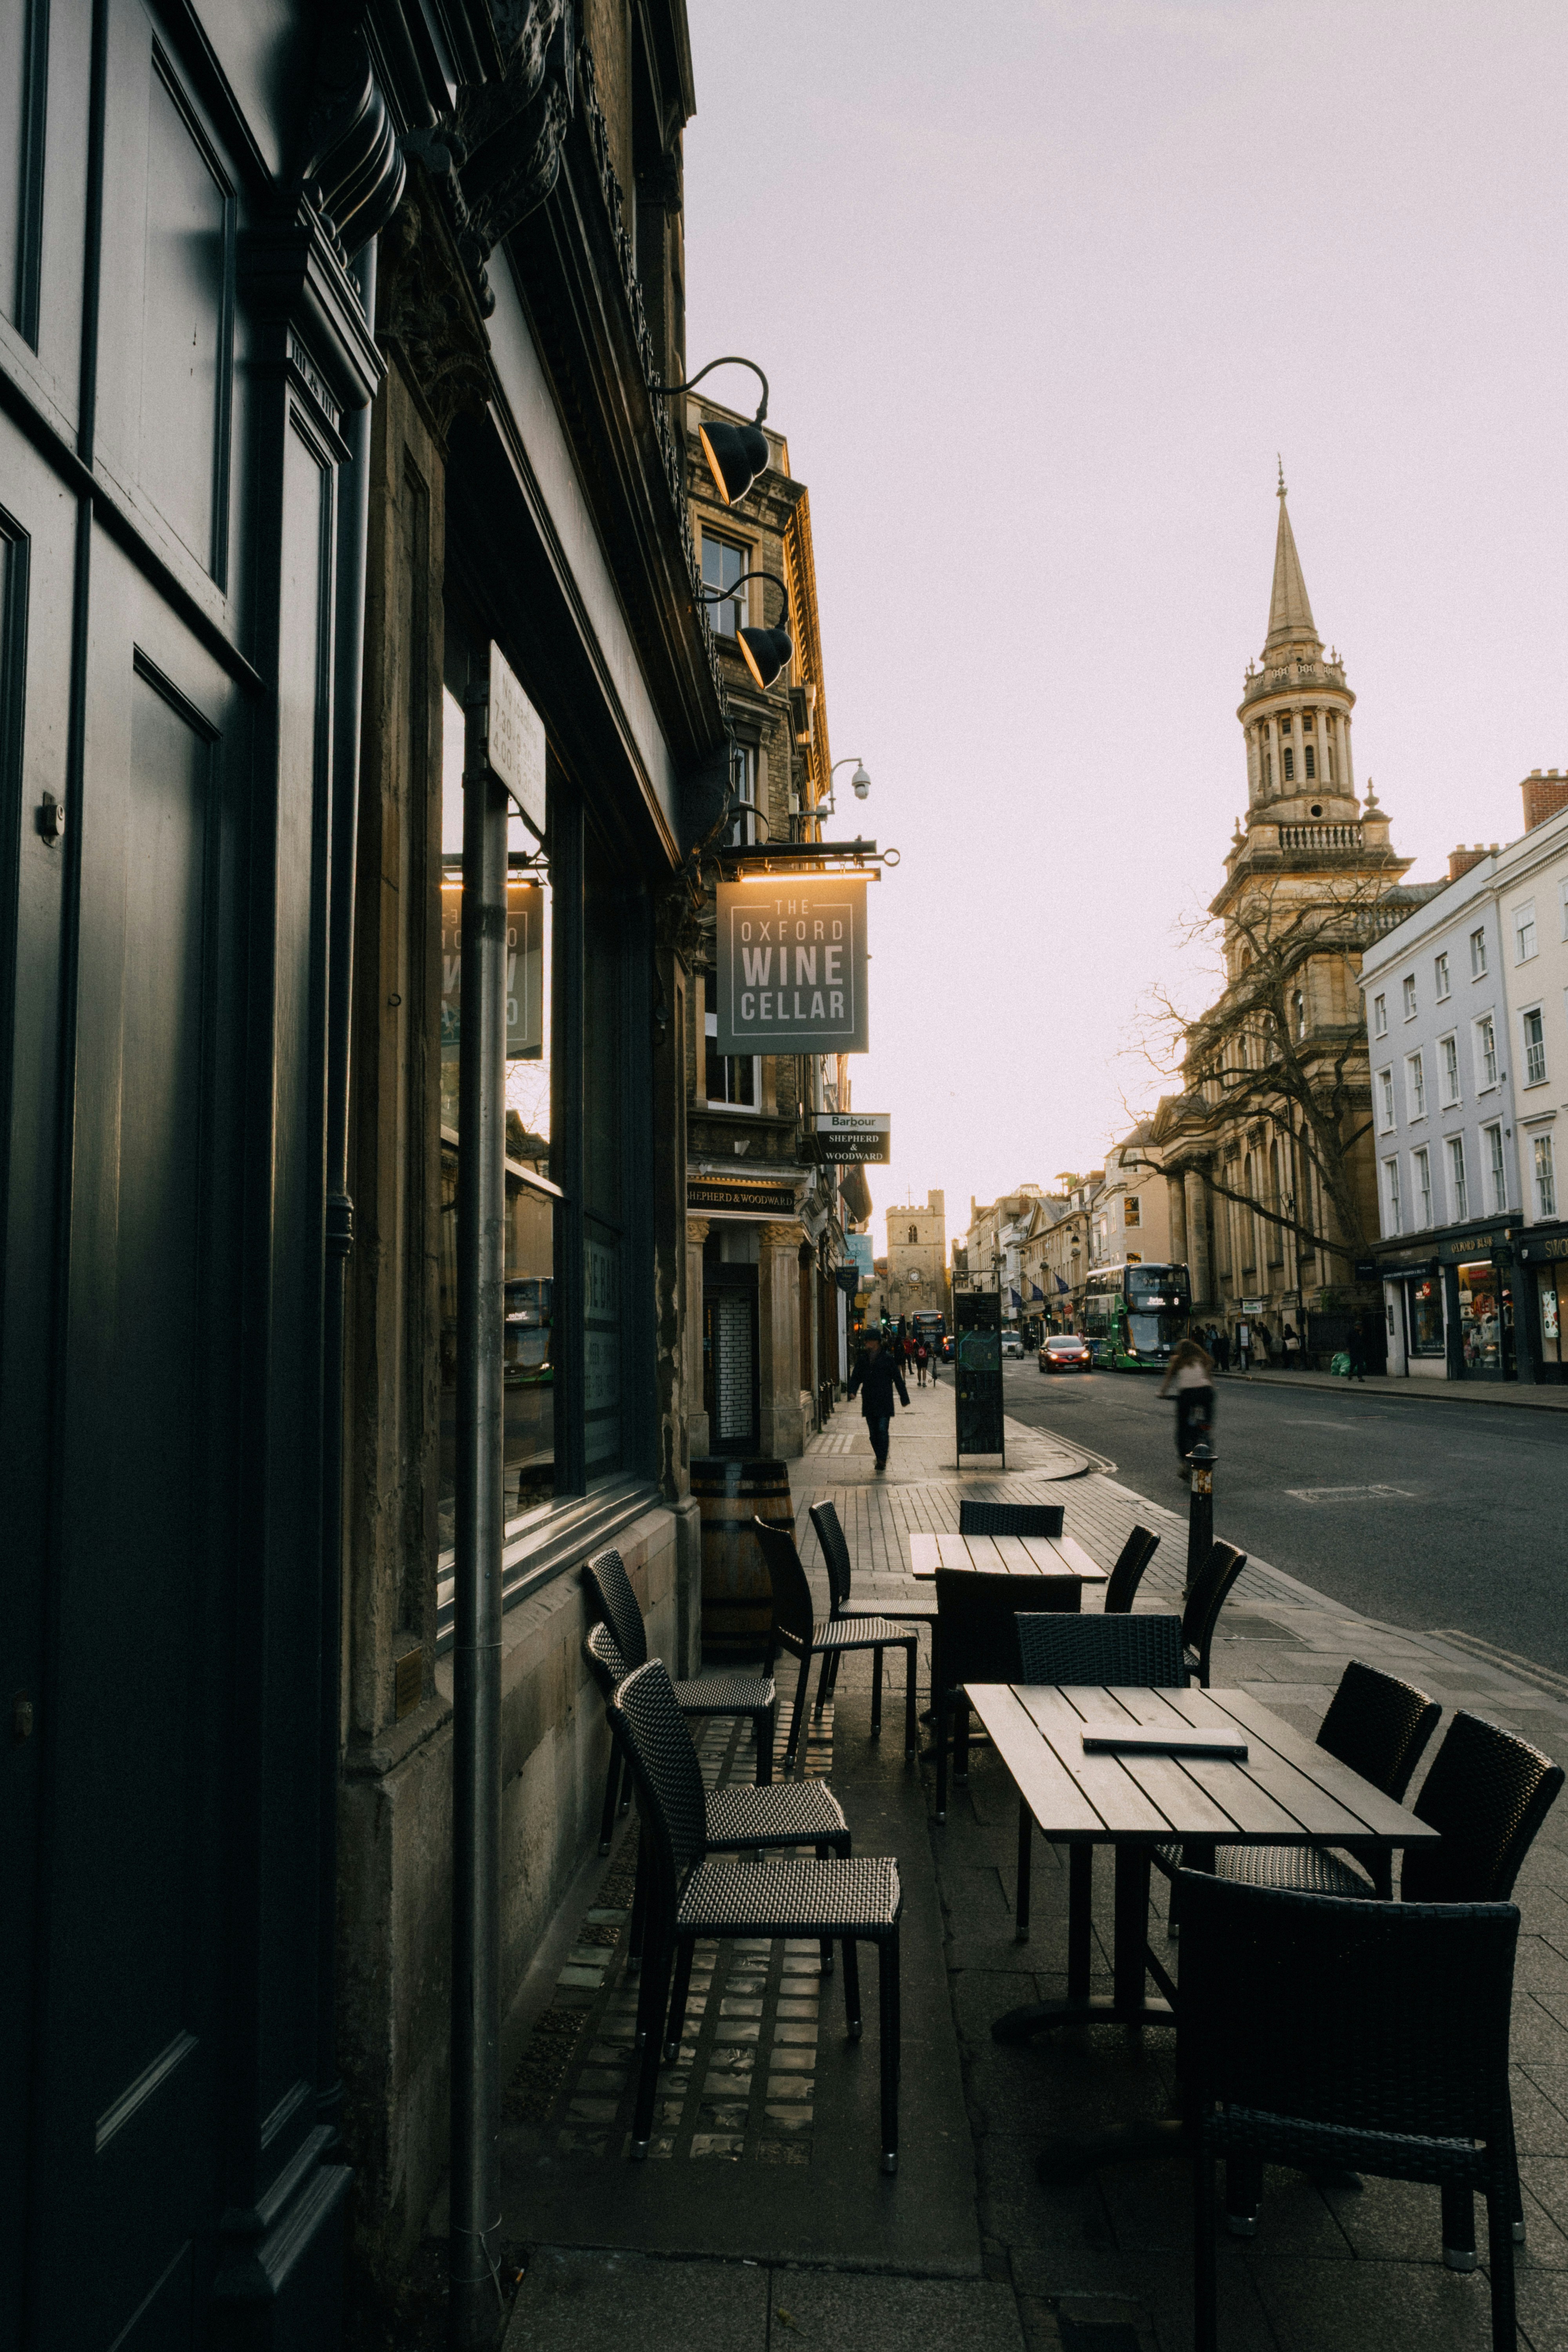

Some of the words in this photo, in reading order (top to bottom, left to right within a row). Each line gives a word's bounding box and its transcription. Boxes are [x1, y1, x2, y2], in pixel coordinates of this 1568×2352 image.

[503, 673, 512, 706] No
[495, 699, 512, 740] 7.30
[493, 731, 512, 771] 4.00
[775, 899, 809, 915] THE
[741, 920, 843, 942] OXFORD
[742, 945, 843, 986] WINE
[741, 991, 844, 1020] CELLAR
[832, 1116, 876, 1126] Barbour
[733, 1194, 740, 1203] &
[740, 1194, 793, 1206] WOODWARD
[1451, 1241, 1475, 1253] OXFORD
[1477, 1236, 1492, 1248] BLUE
[1545, 1239, 1568, 1257] SWO
[1174, 1297, 1179, 1305] 8
[1470, 1300, 1490, 1315] SALE
